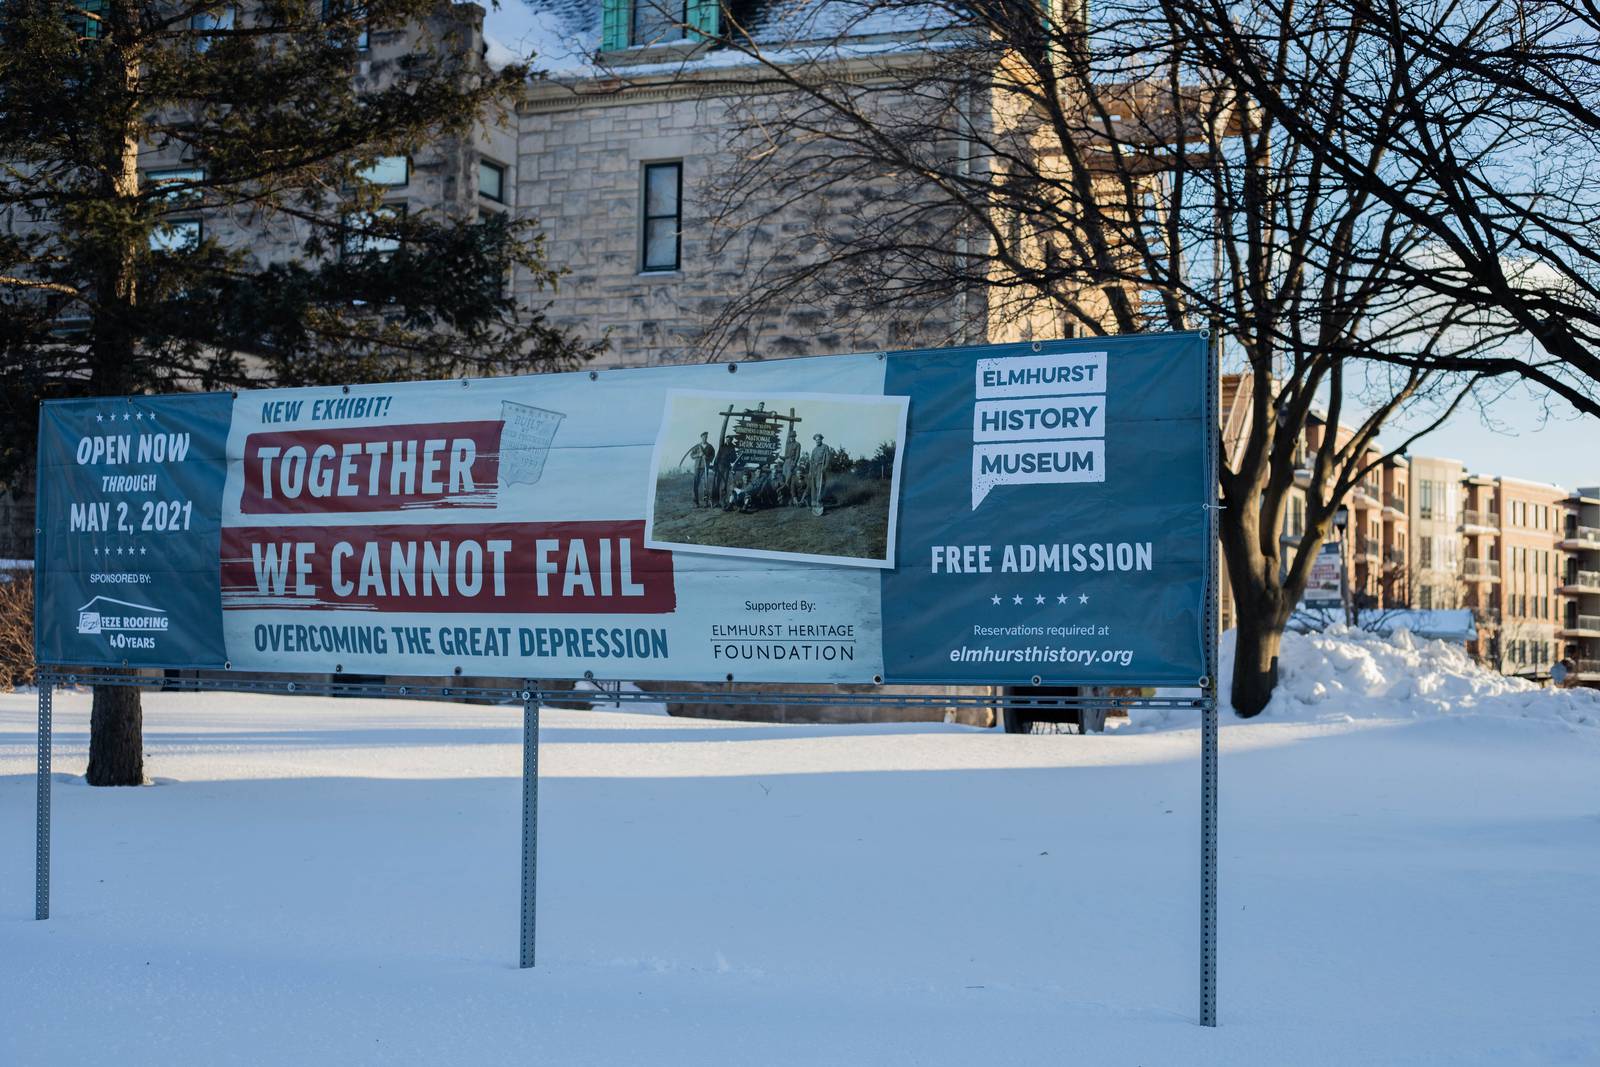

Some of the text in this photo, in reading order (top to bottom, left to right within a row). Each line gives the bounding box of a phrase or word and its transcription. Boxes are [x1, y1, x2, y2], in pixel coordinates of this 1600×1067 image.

[983, 365, 1098, 387] ELMHURST
[262, 396, 392, 423] NEW EXHIBIT!
[981, 406, 1098, 431] HISTORY
[76, 433, 190, 465] OPEN NOW
[258, 438, 476, 499] TOGETHER
[981, 452, 1094, 474] MUSEUM
[102, 475, 156, 492] THROUGH
[70, 501, 192, 535] MAY 2, 2021
[251, 538, 645, 597] WE CANNOT FAIL
[931, 542, 1152, 574] FREE ADMISSION
[90, 574, 151, 583] SPONSORED BY:
[745, 600, 816, 612] Supported By:
[101, 617, 168, 628] FEZE ROOFING
[712, 625, 854, 636] ELMHURST HERITAGE
[974, 624, 1109, 636] Reservations required at
[254, 624, 669, 658] OVERCOMING THE GREAT DEPRESSION
[714, 645, 854, 661] FOUNDATION
[950, 645, 1133, 666] elmhursthistory.org
